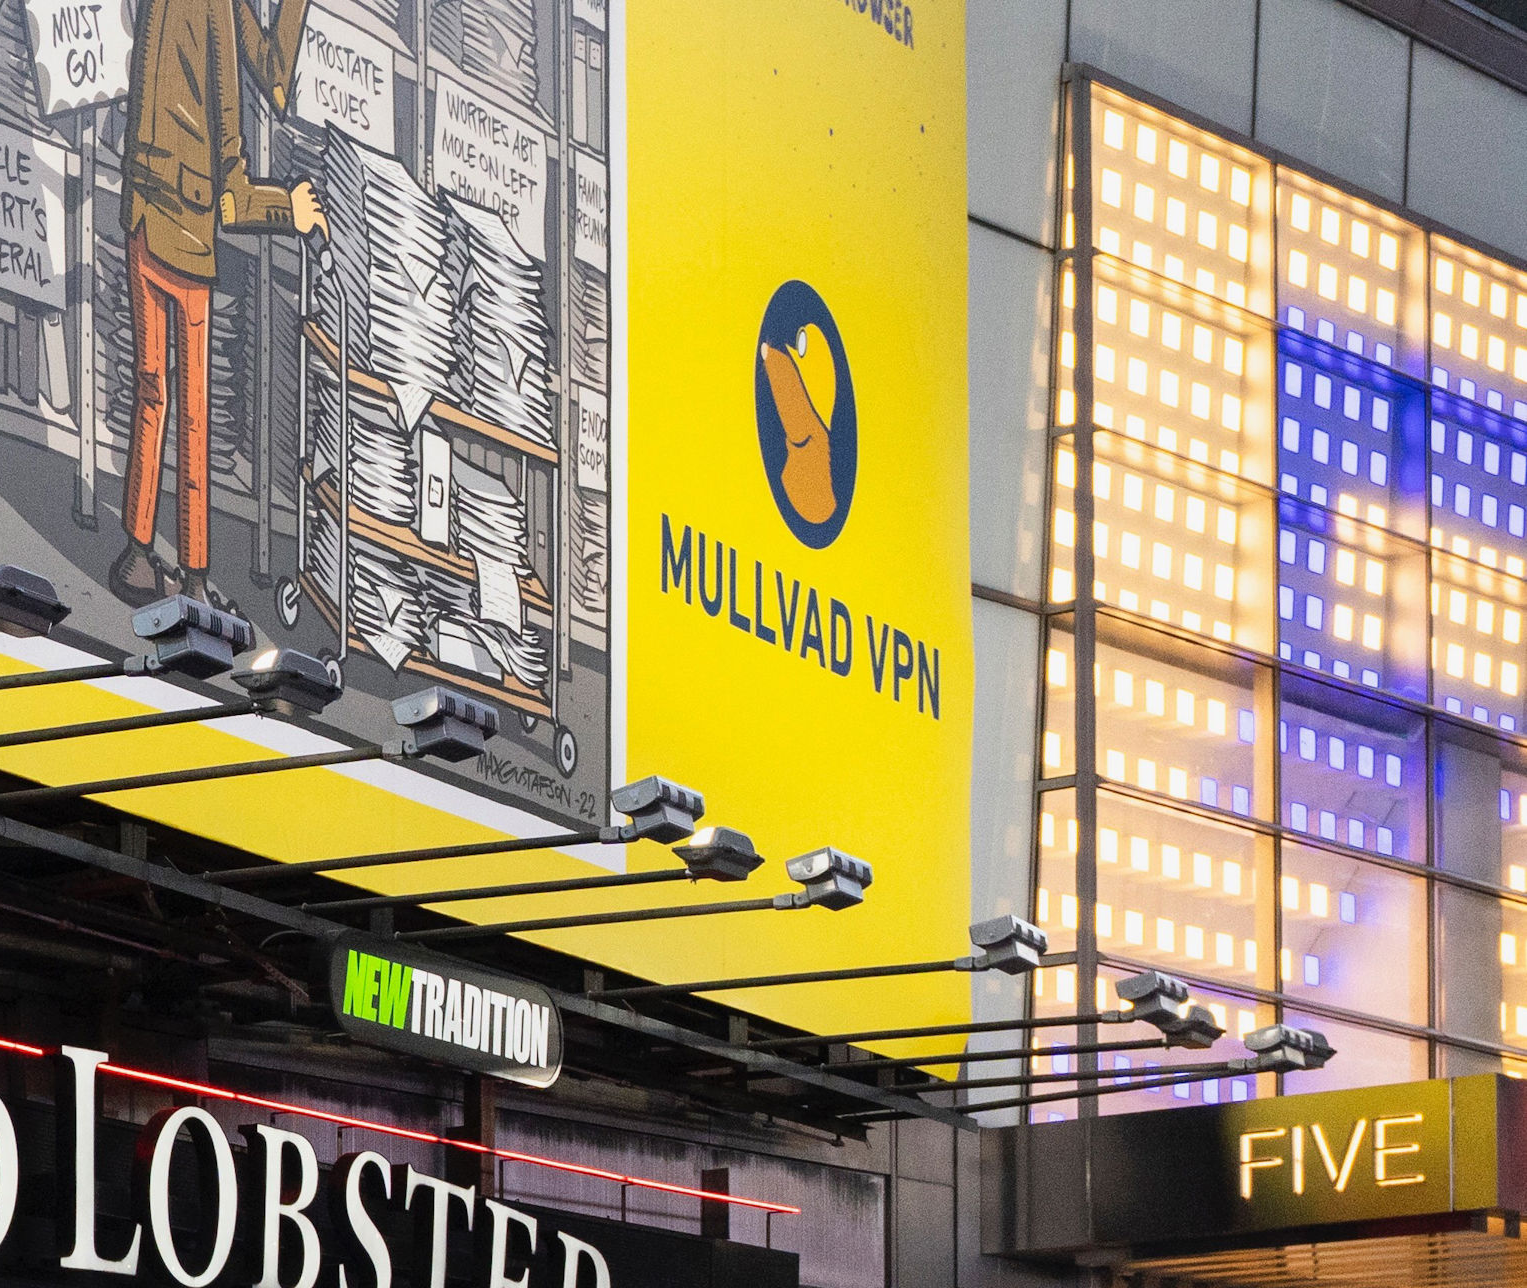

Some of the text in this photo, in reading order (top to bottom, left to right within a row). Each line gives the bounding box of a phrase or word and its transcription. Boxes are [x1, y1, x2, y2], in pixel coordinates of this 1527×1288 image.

[52, 4, 104, 48] MUST
[65, 47, 108, 89] GO!
[306, 25, 385, 96] PROSTATE
[314, 76, 371, 131] ISSUES
[446, 90, 510, 149] WORRIES
[442, 128, 538, 206] MOLE ON LEFT
[659, 512, 941, 722] MULLVAD VPN
[1239, 1112, 1425, 1200] FIVE
